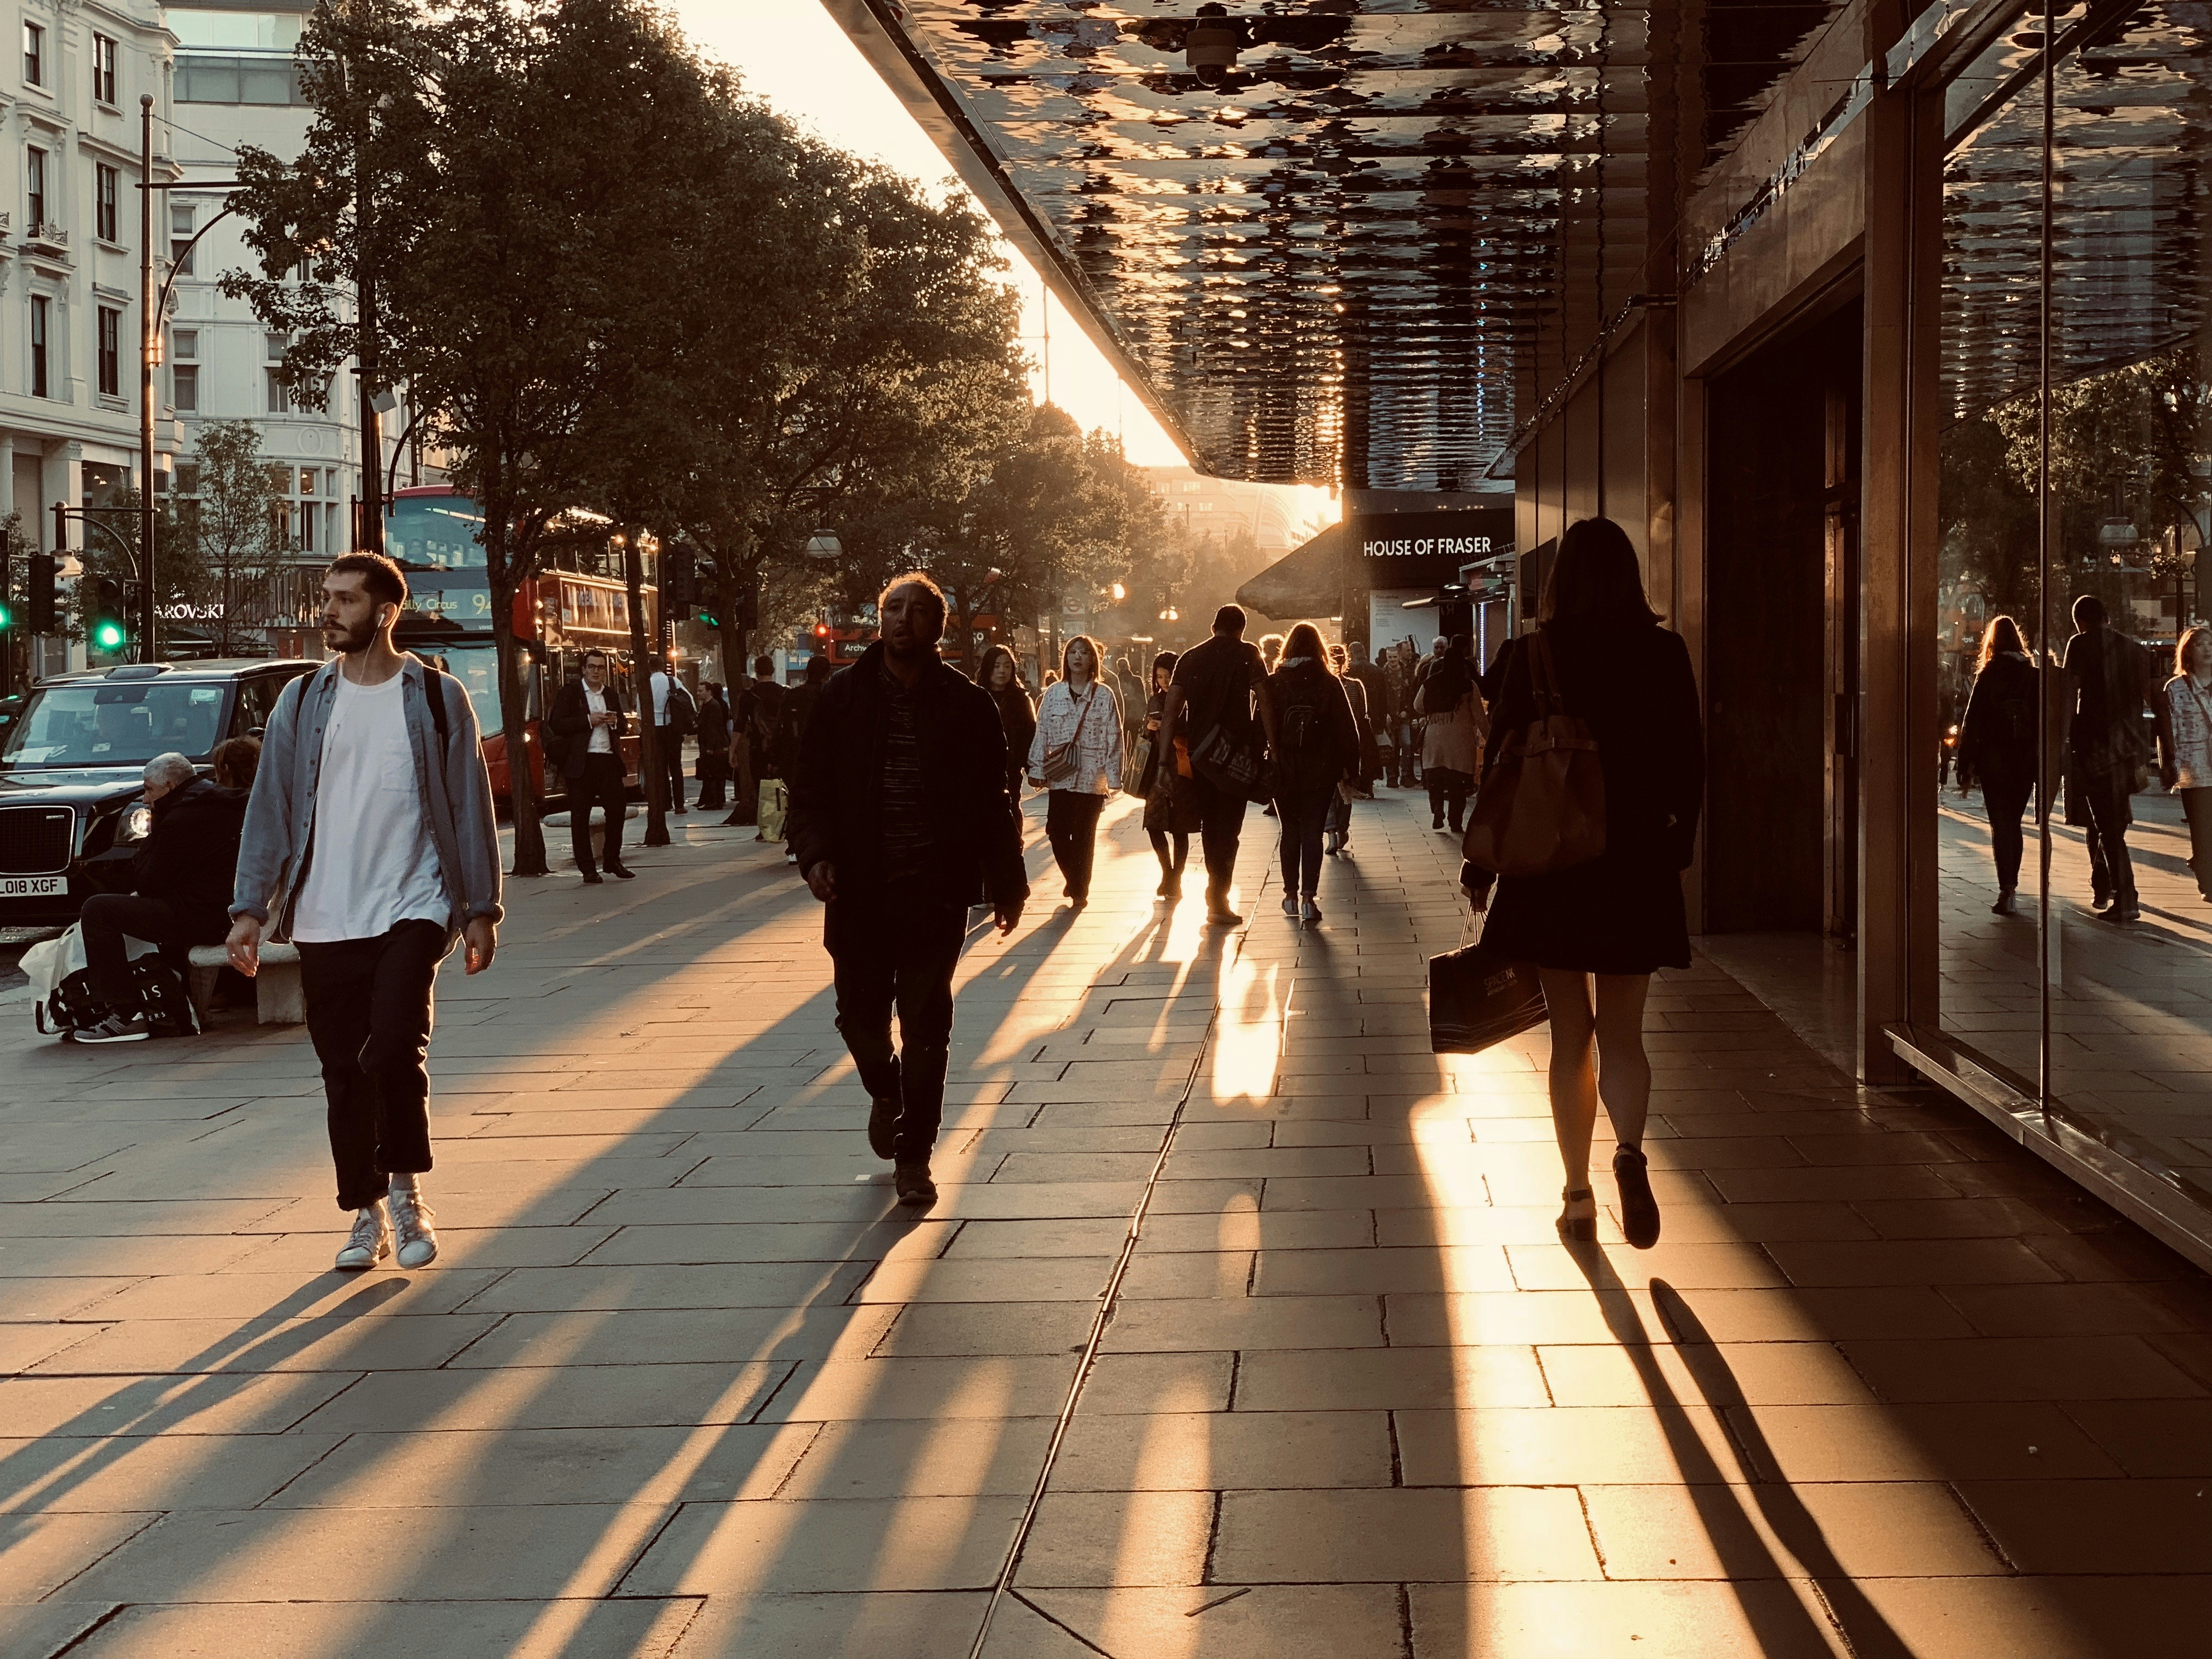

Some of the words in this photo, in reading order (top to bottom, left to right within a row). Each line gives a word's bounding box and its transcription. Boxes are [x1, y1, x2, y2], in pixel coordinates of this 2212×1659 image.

[1364, 540, 1412, 556] HOUSE
[1414, 539, 1435, 555] OF
[1437, 537, 1491, 554] FRASER
[154, 604, 224, 619] AROVSKI
[402, 599, 421, 612] dilly
[426, 599, 458, 610] Circus
[31, 879, 58, 893] XGF
